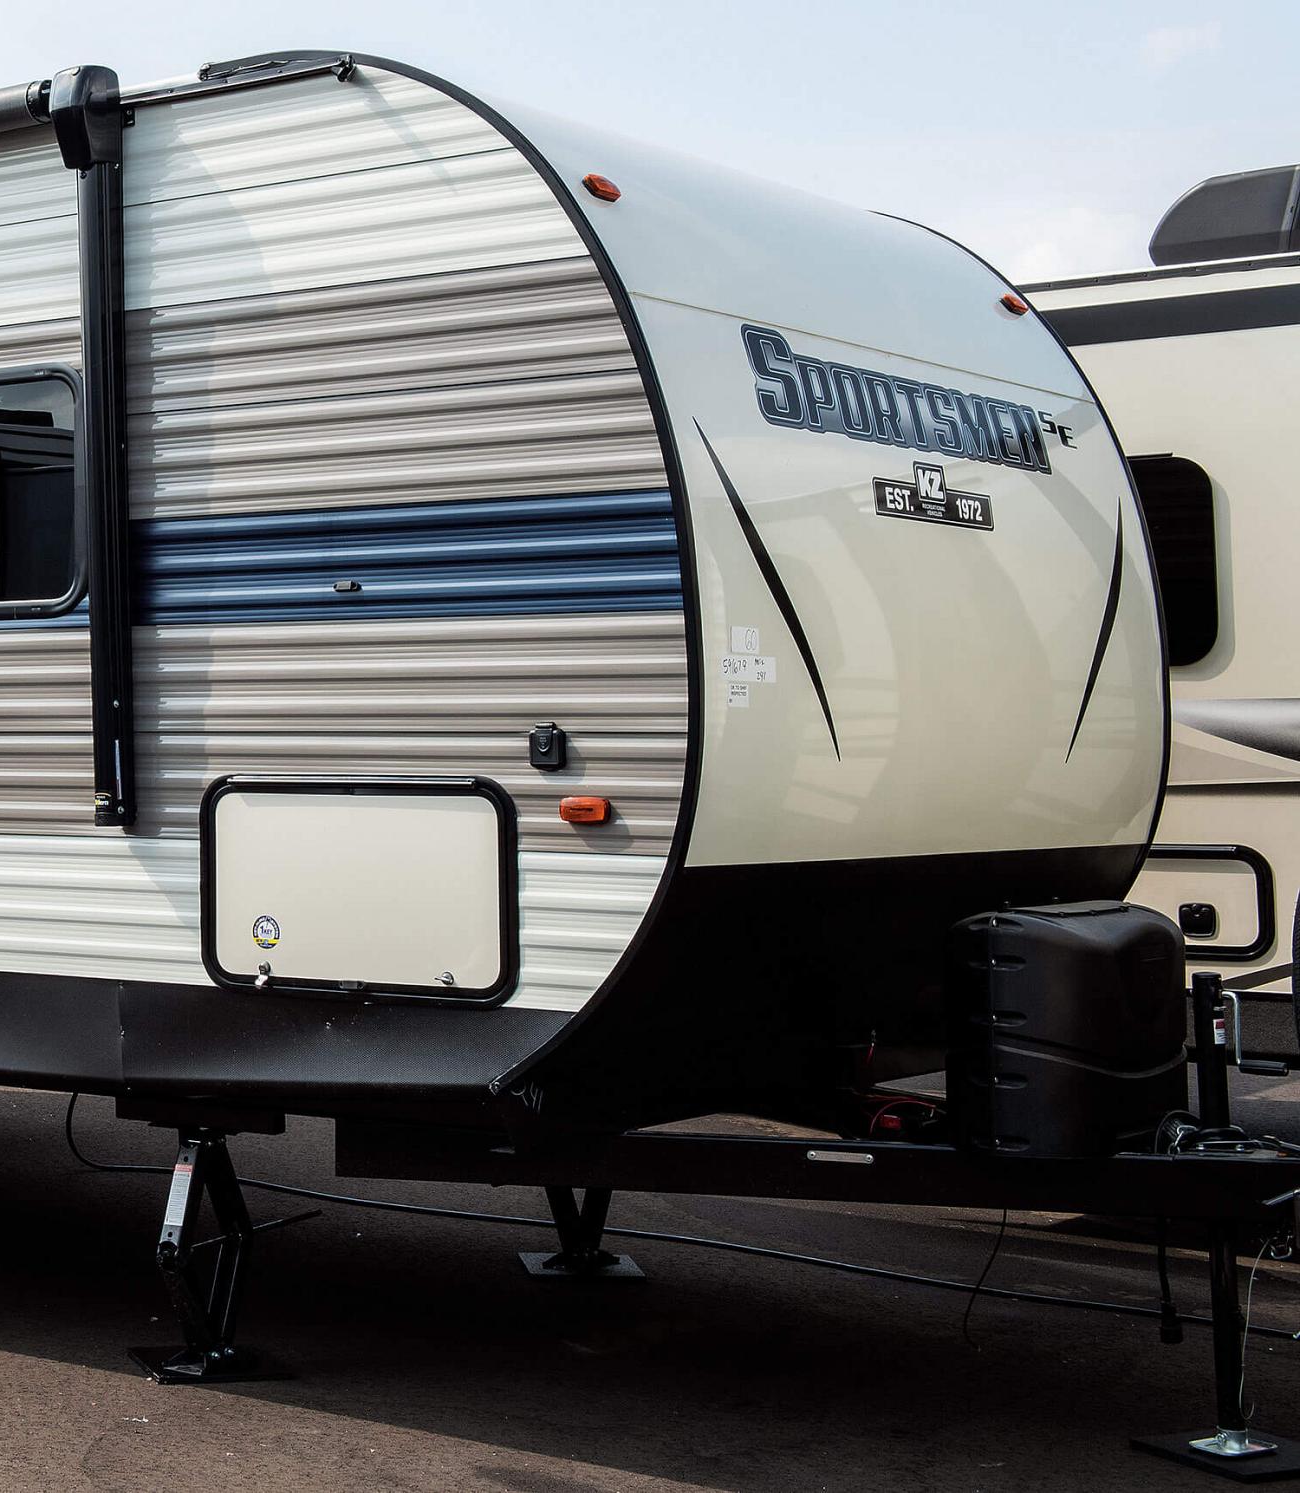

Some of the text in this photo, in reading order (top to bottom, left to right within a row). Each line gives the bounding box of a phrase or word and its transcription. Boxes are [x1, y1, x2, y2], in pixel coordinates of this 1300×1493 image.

[741, 324, 1078, 475] SPORTSMEN SE
[917, 469, 945, 499] KZ
[885, 486, 983, 521] EST. 1972
